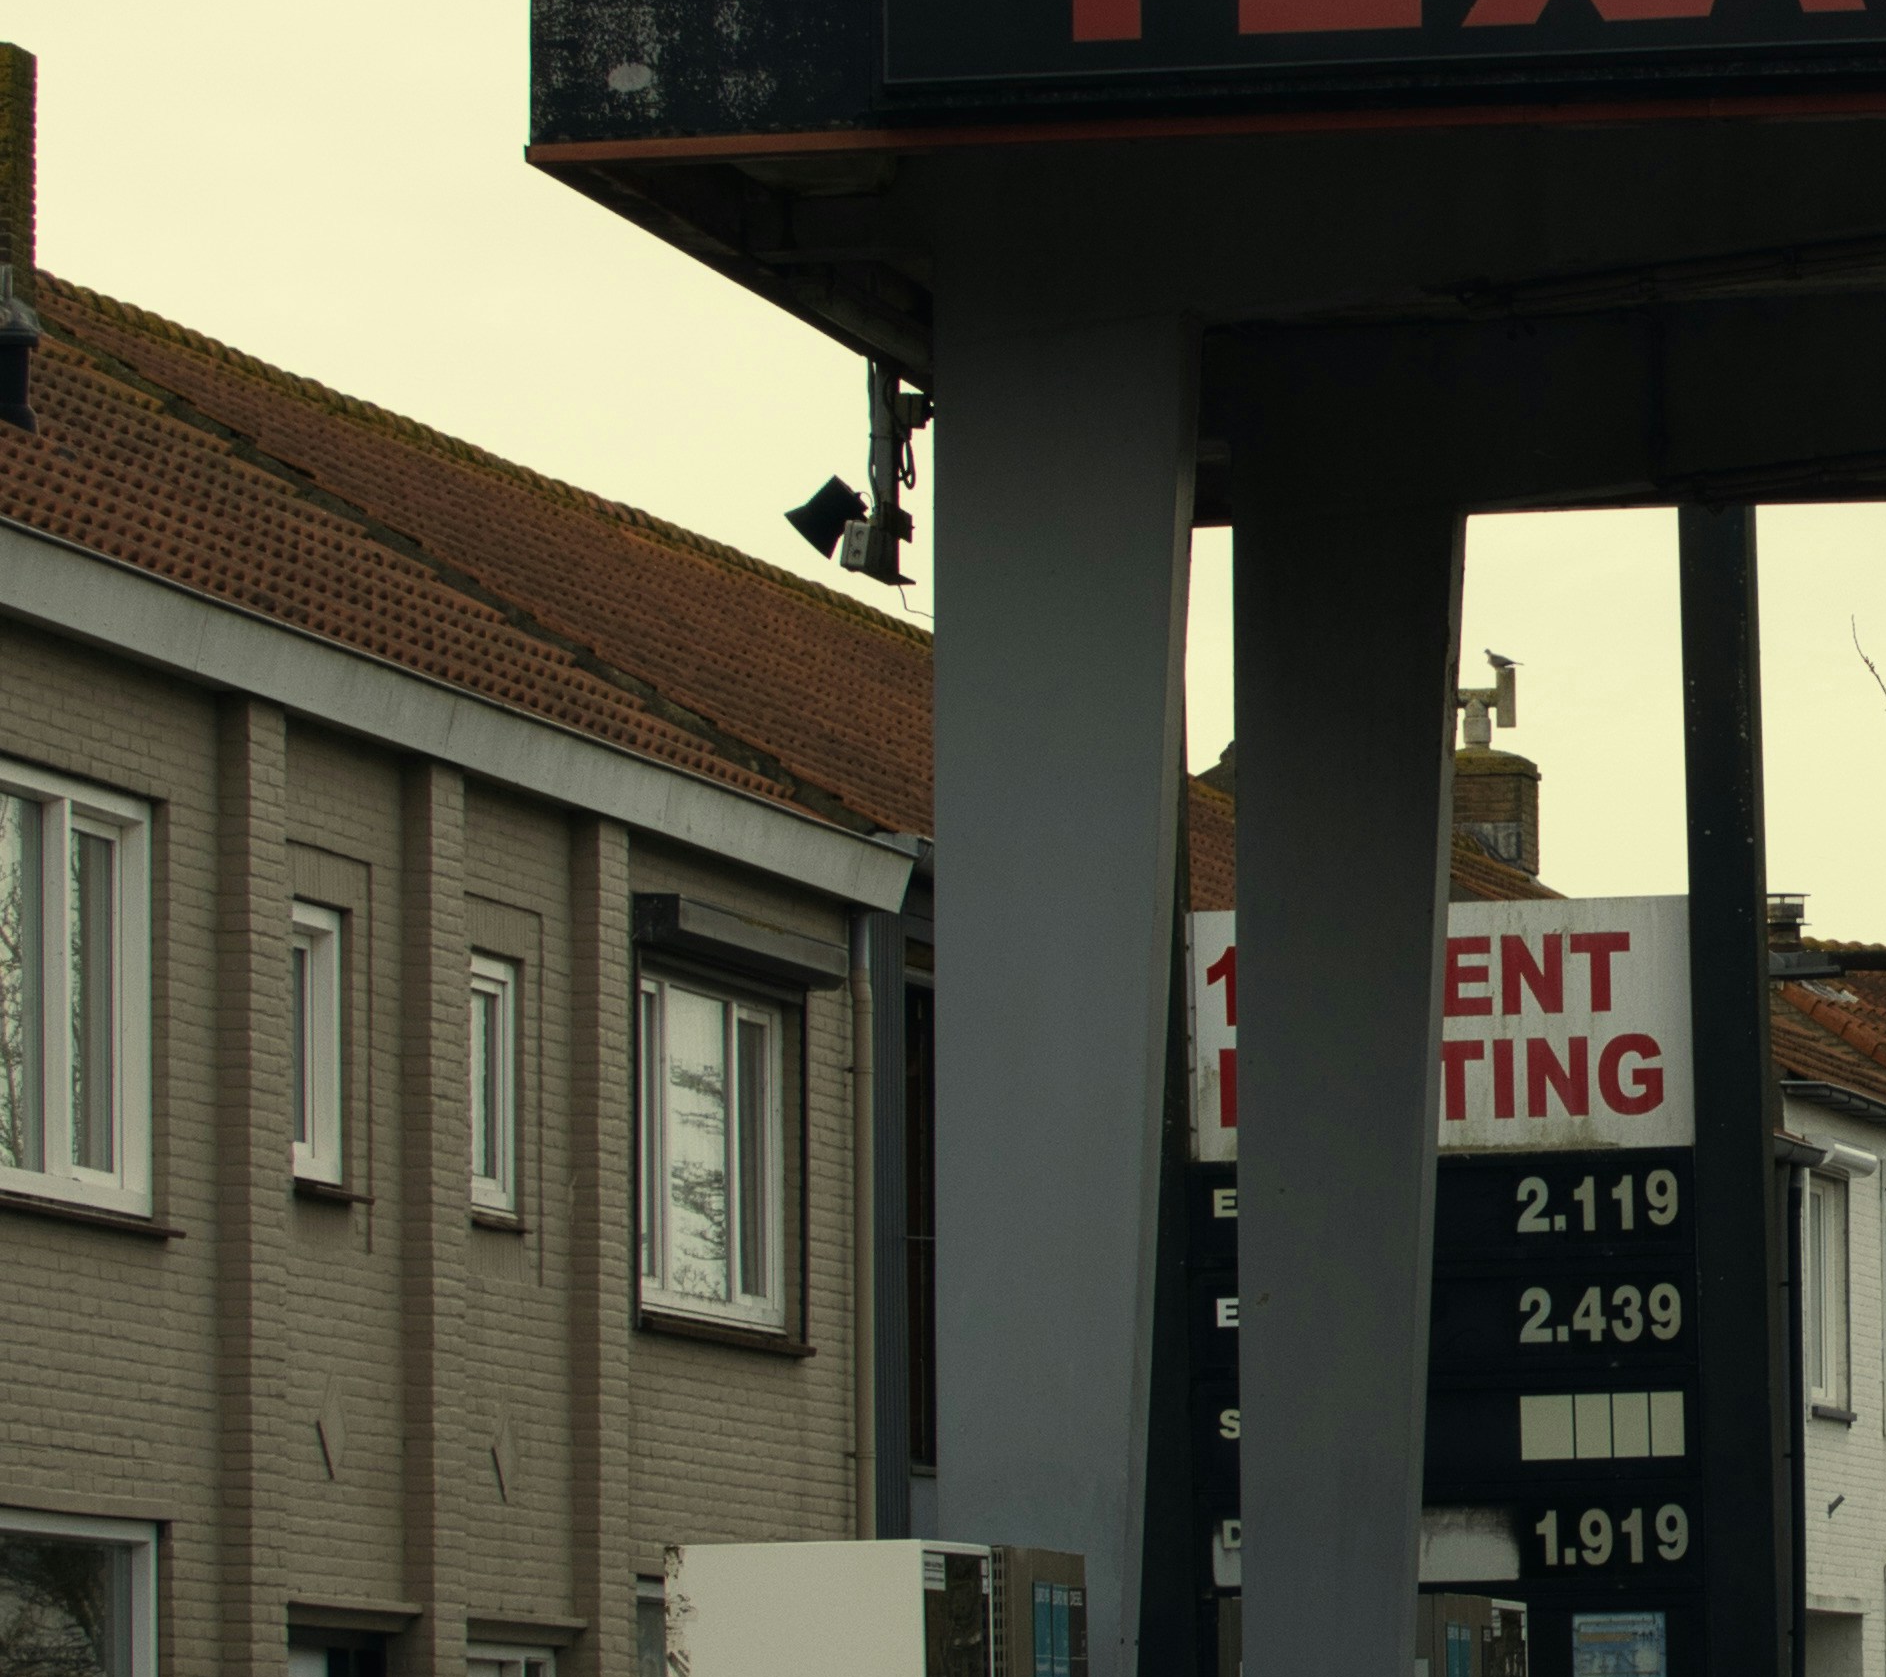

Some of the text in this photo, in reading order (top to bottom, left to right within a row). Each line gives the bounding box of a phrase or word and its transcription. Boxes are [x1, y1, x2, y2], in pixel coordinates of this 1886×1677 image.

[1441, 931, 1631, 1018] ENT
[1516, 1169, 1679, 1233] 2.119
[1519, 1282, 1683, 1344] 2.439
[1535, 1503, 1690, 1566] 1.919
